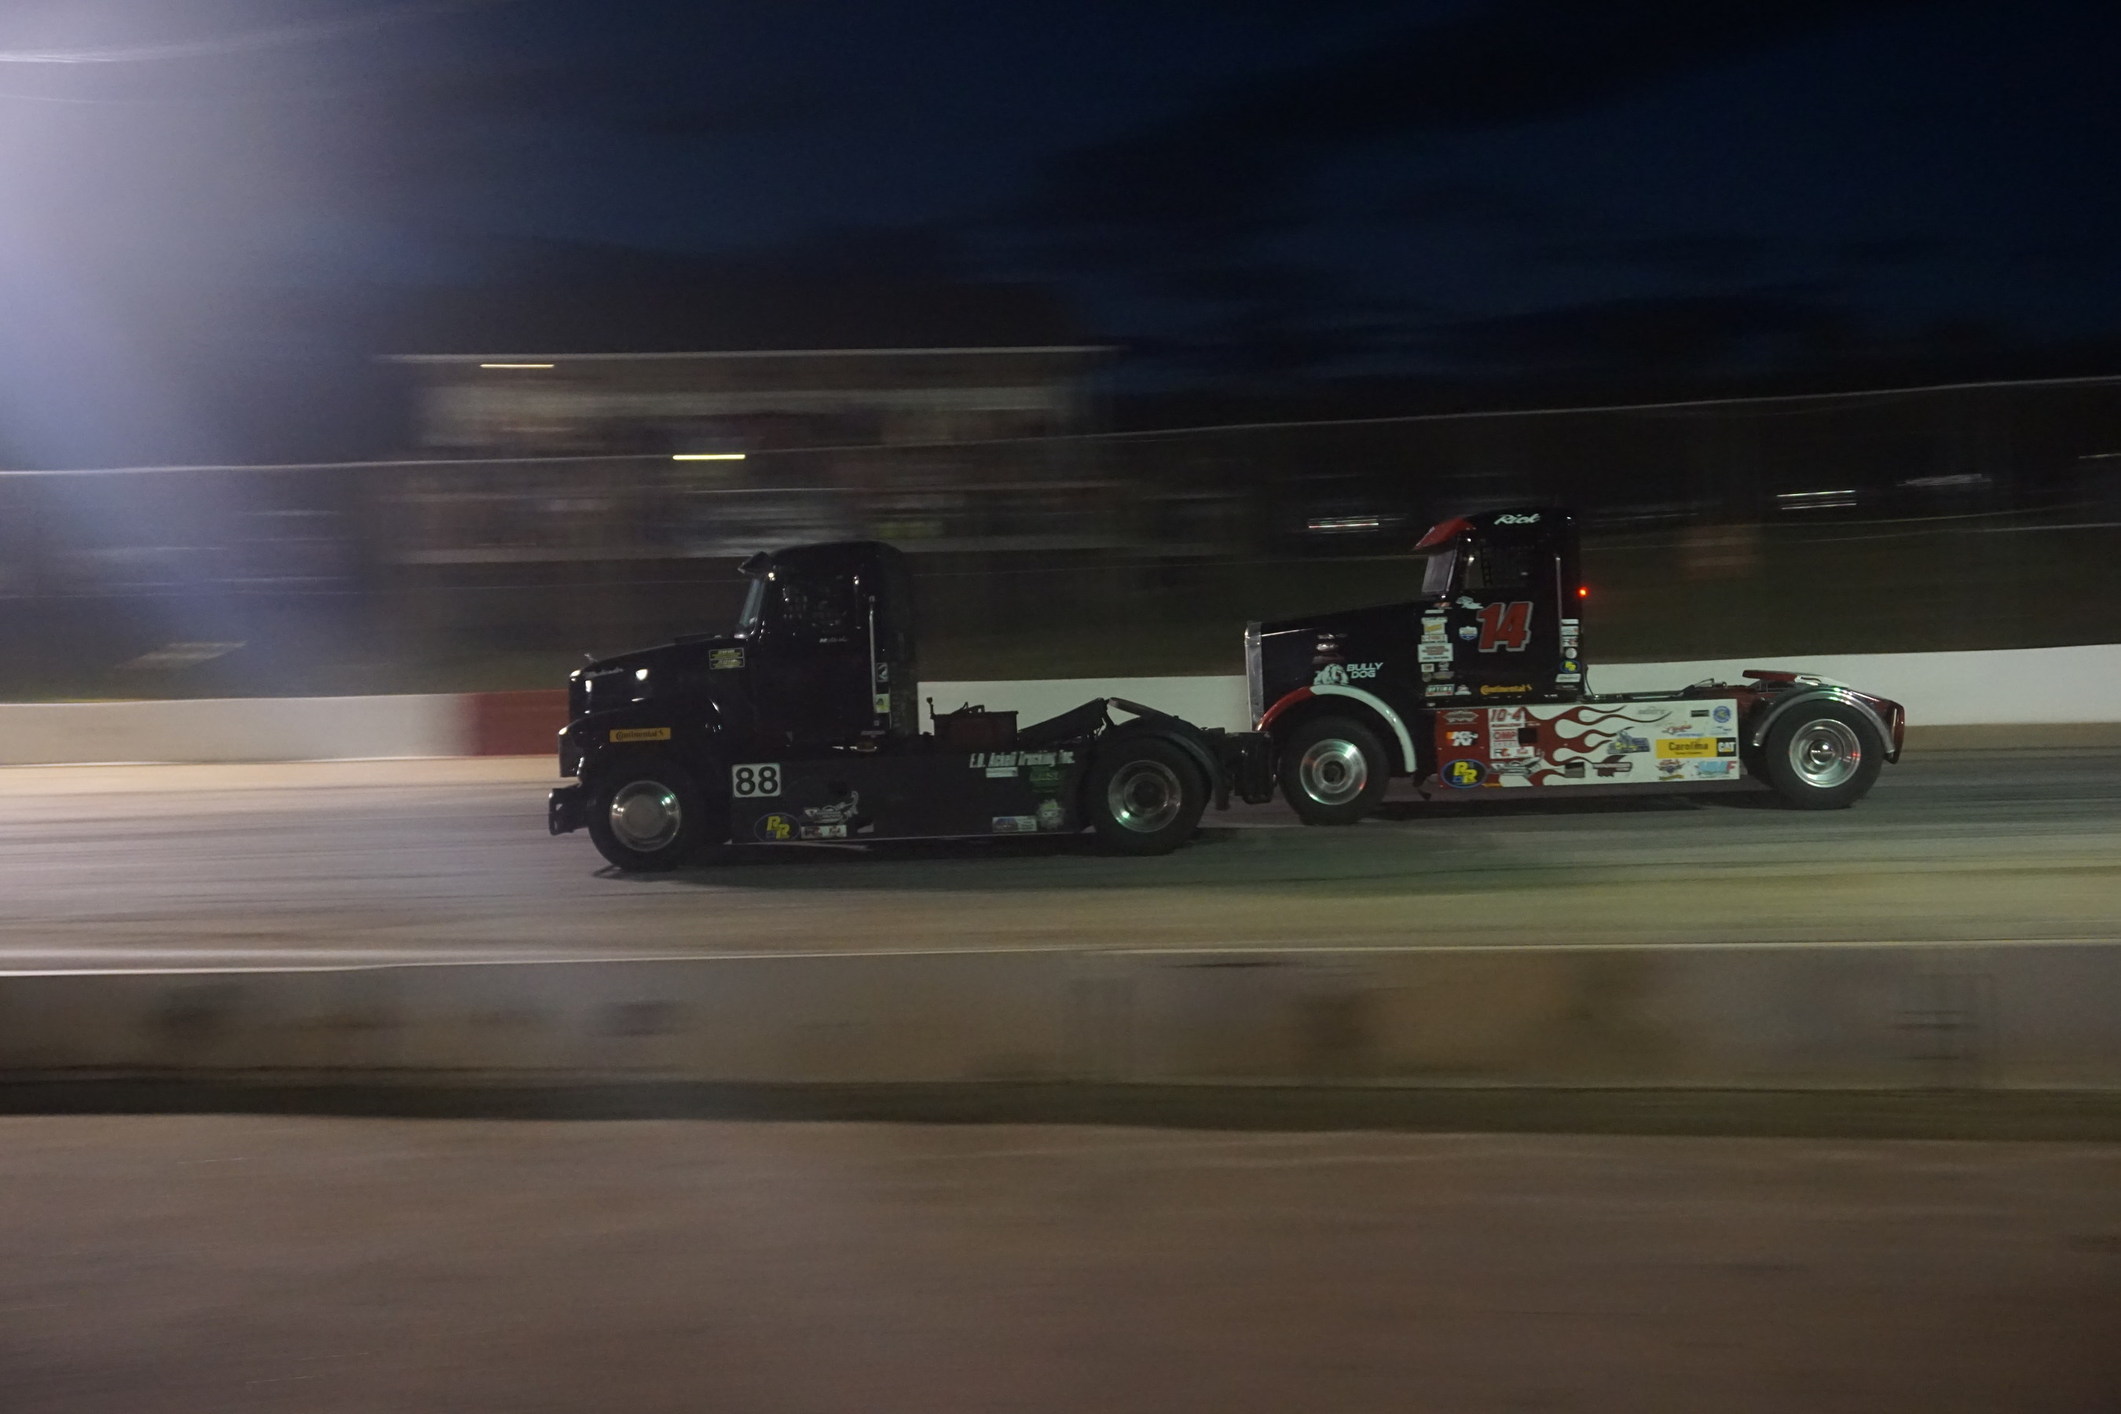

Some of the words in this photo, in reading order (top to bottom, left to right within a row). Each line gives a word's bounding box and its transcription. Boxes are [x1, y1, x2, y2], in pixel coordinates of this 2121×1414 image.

[1476, 601, 1534, 653] 14
[1346, 662, 1384, 671] BULLY
[1351, 670, 1376, 679] DOG
[1480, 684, 1526, 695] Continental
[1491, 707, 1522, 722] 10-4
[615, 730, 657, 741] Continental
[1668, 741, 1709, 751] Carolina
[1718, 742, 1736, 752] CAT
[736, 766, 778, 796] 88
